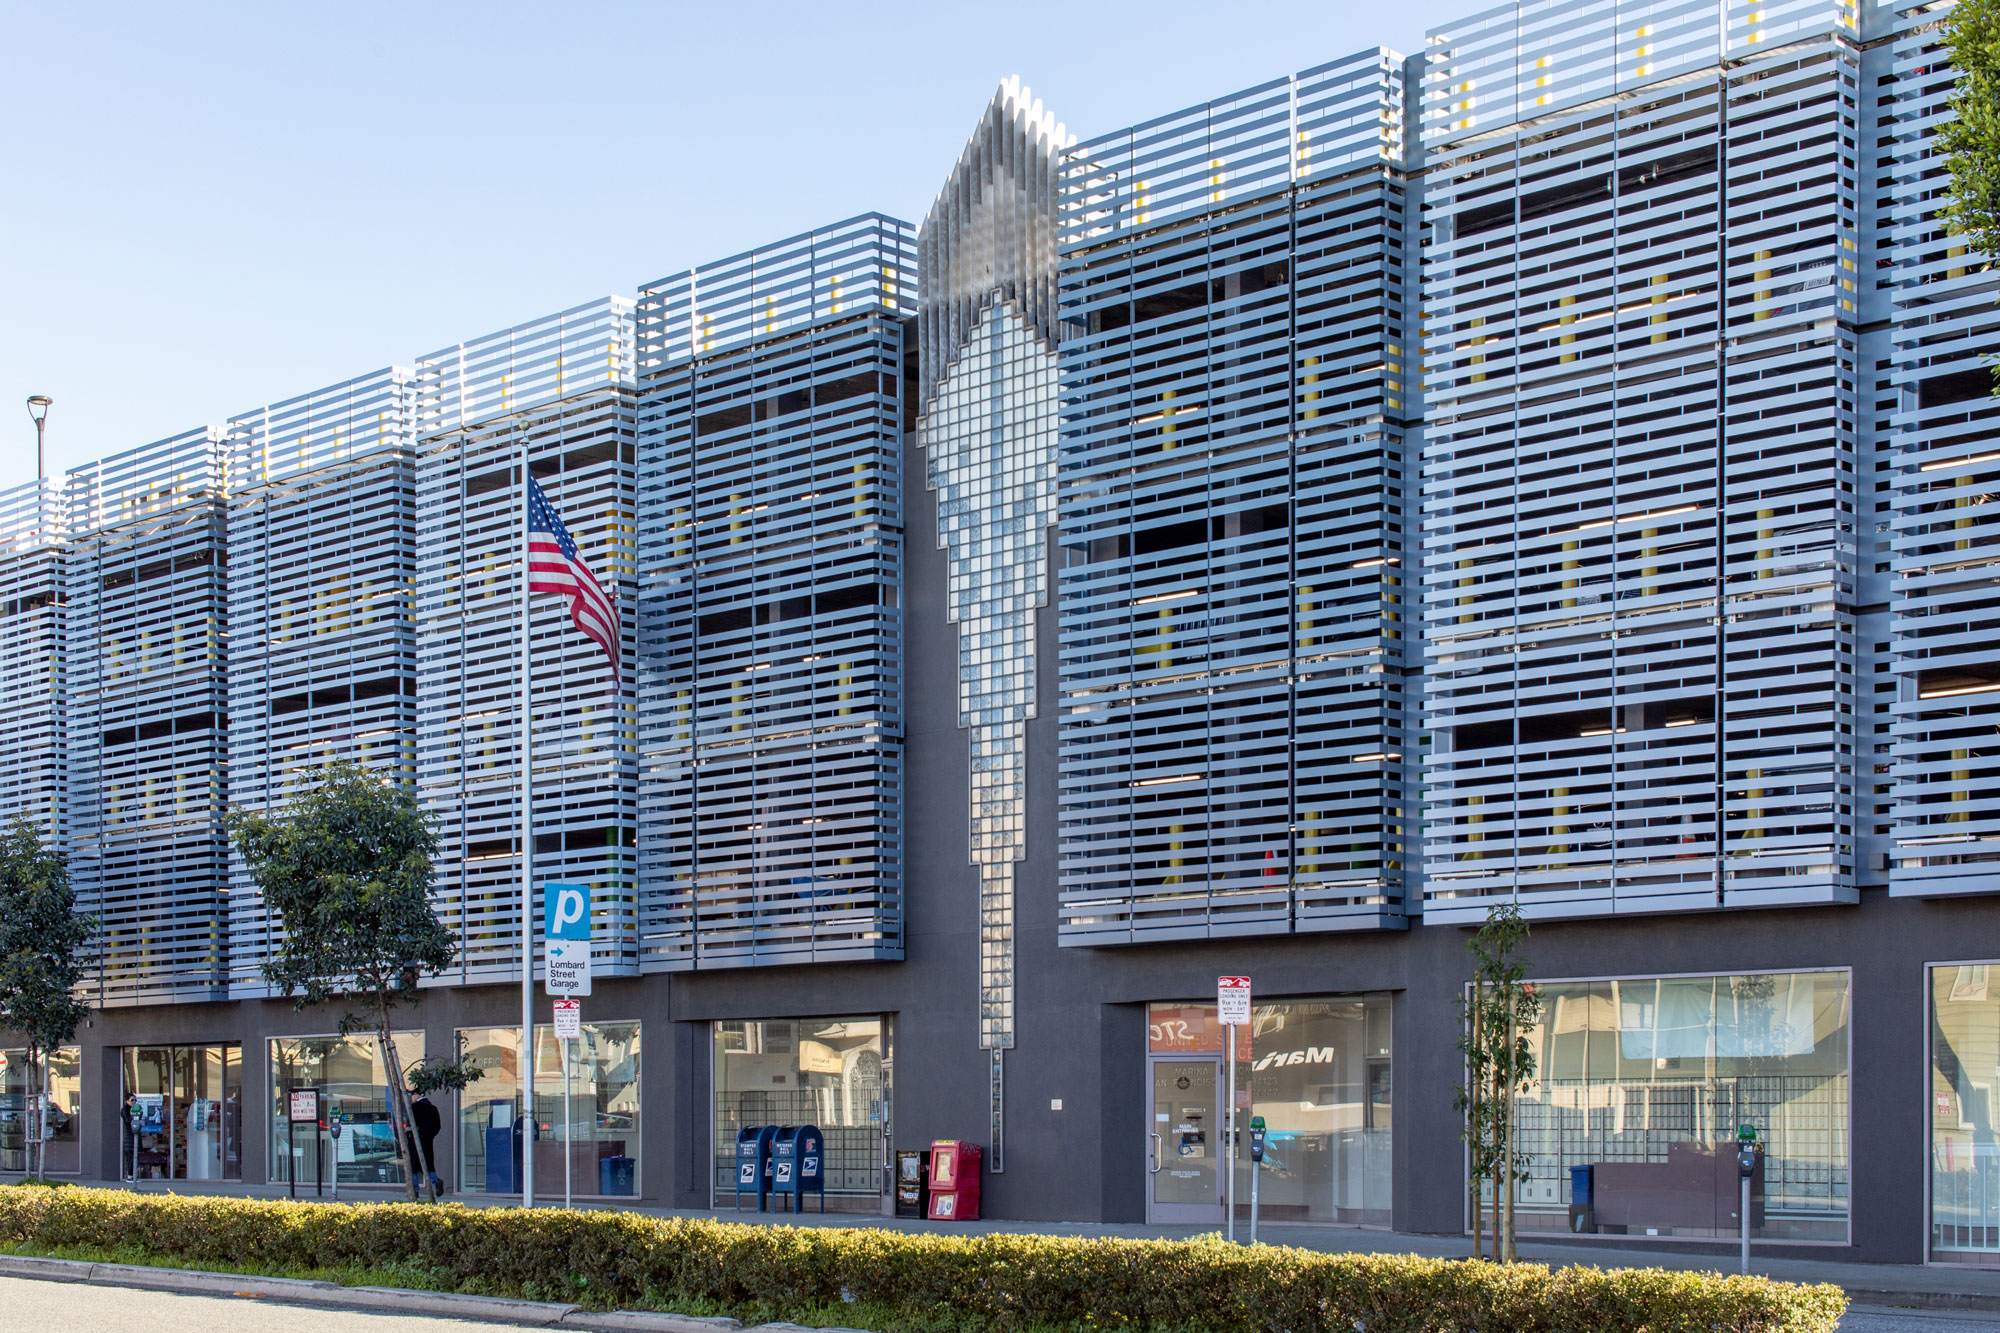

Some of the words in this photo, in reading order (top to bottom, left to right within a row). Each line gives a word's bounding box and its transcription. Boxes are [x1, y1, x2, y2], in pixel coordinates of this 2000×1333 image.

[550, 960, 585, 969] Lombard
[550, 969, 576, 978] Street
[550, 979, 579, 990] Garage
[478, 1057, 503, 1068] OFFIC
[1175, 1067, 1209, 1076] MARINA
[1155, 1079, 1167, 1088] AN
